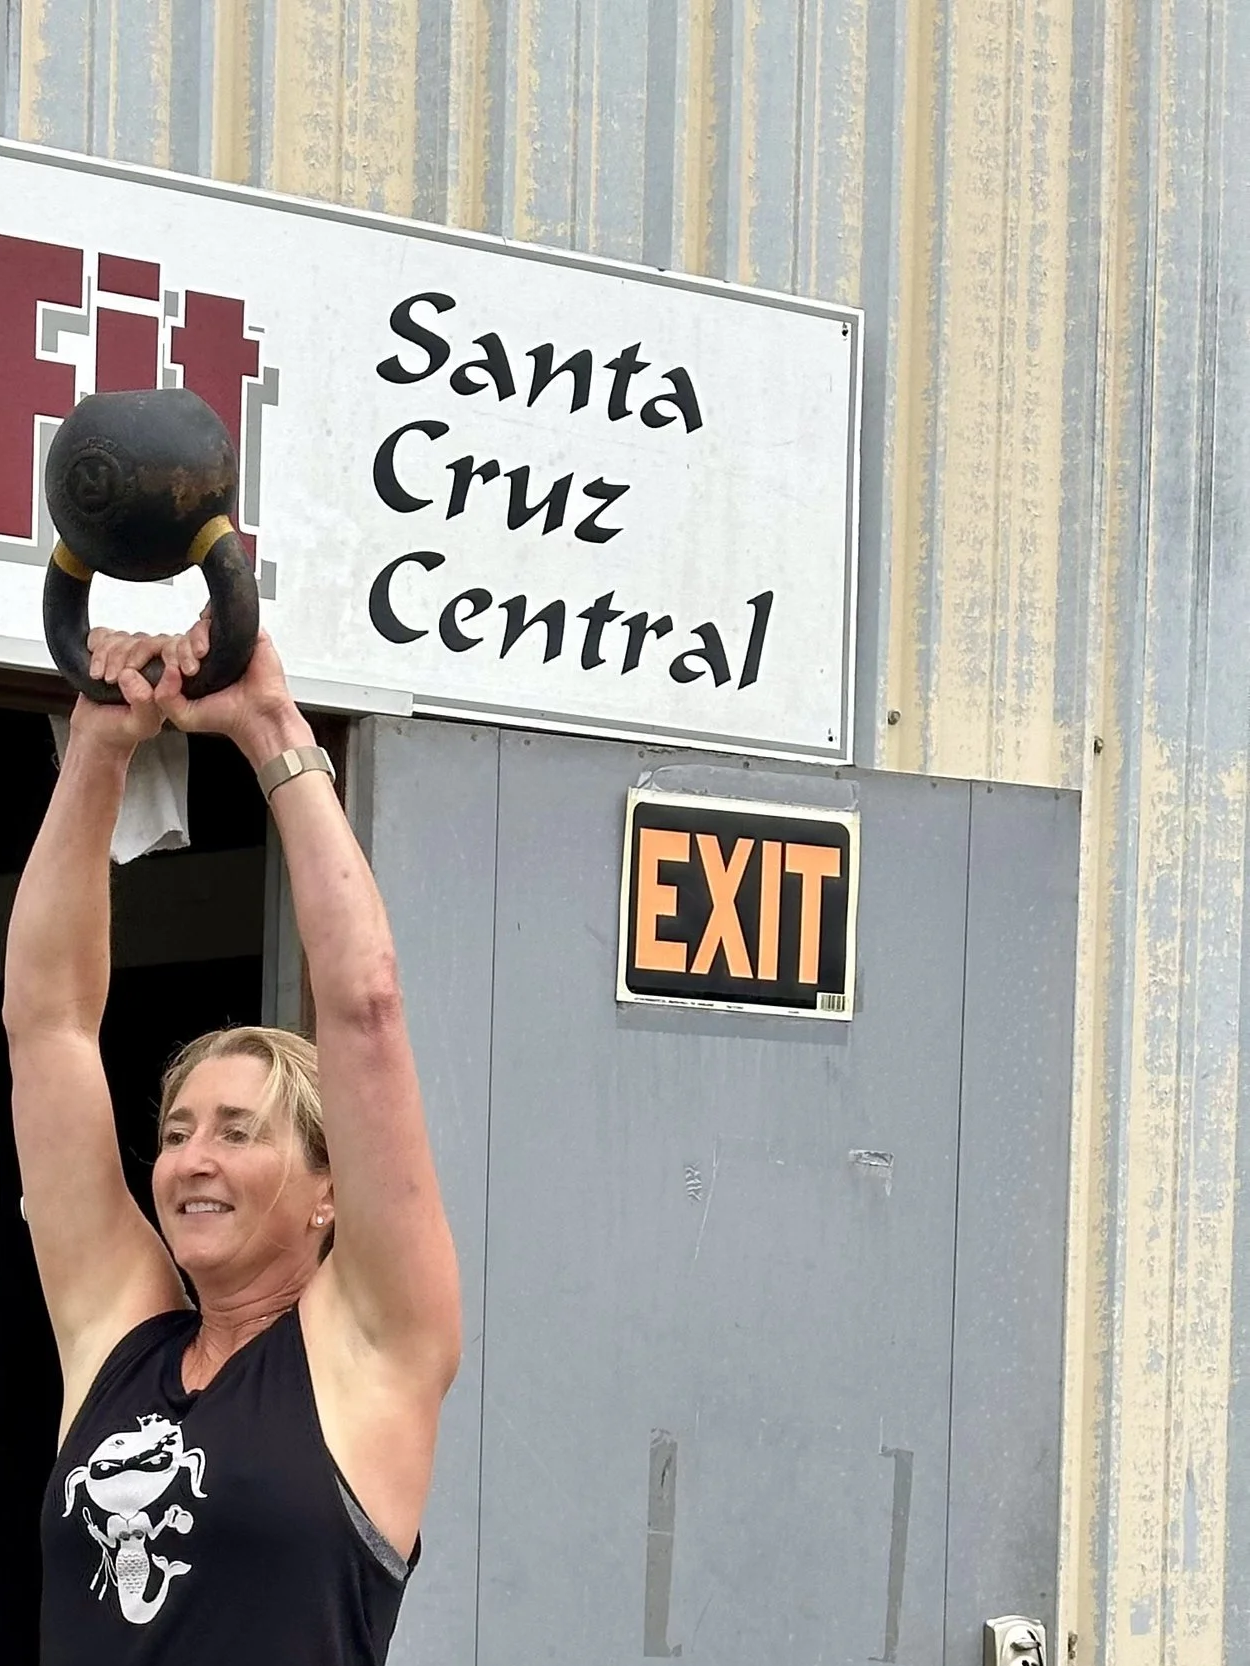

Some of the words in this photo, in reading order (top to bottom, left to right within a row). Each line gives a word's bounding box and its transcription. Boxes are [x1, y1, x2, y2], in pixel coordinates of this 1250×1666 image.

[375, 292, 703, 434] Santa
[372, 419, 631, 544] Cruz
[368, 551, 774, 691] Central
[635, 827, 841, 985] EXIT
